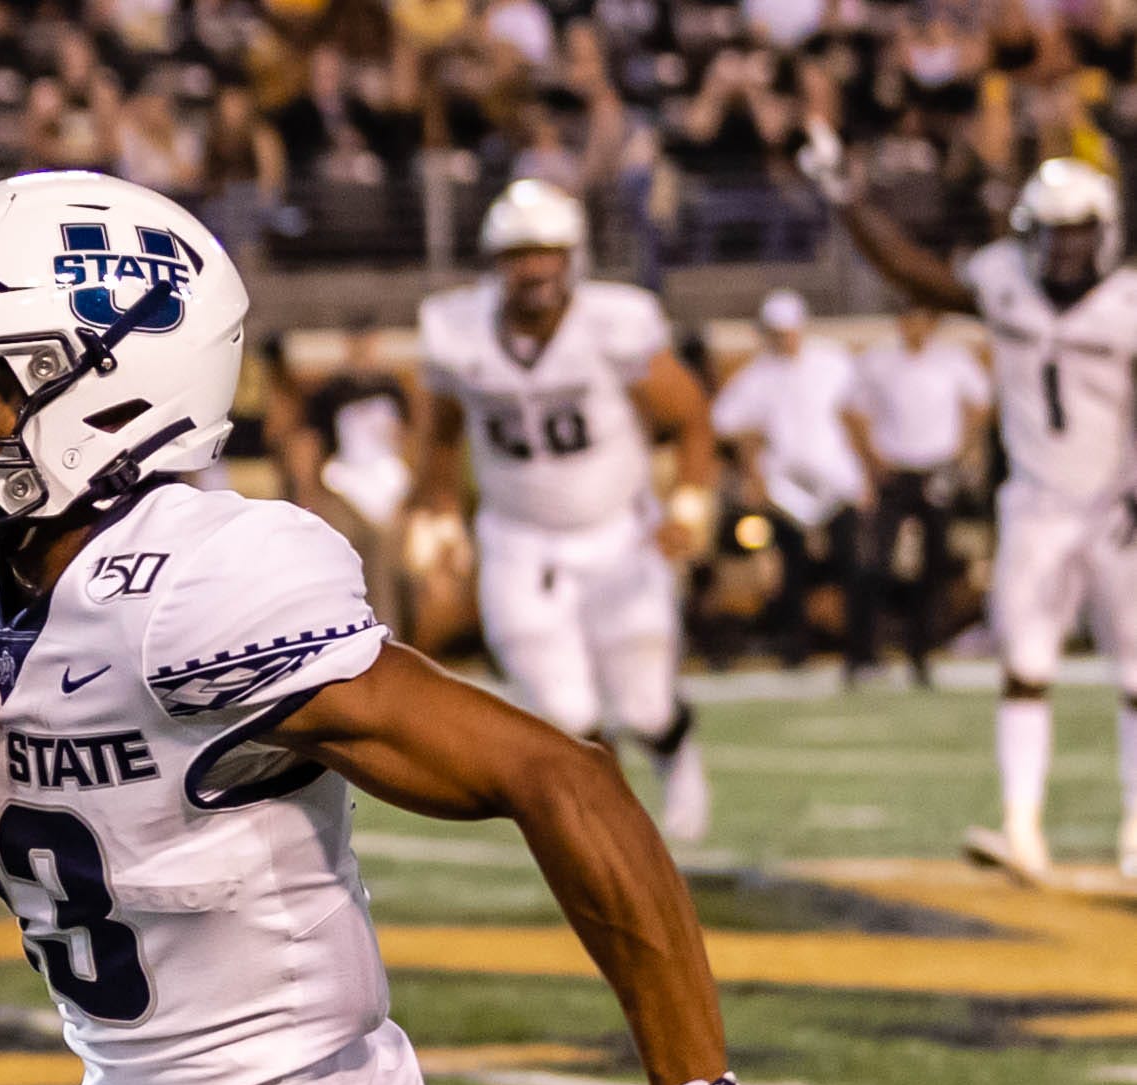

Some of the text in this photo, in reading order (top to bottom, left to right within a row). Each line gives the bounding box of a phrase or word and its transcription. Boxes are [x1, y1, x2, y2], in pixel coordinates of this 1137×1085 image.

[53, 253, 192, 297] STATE
[1037, 360, 1068, 434] 1
[86, 551, 171, 604] 150
[7, 728, 161, 792] STATE
